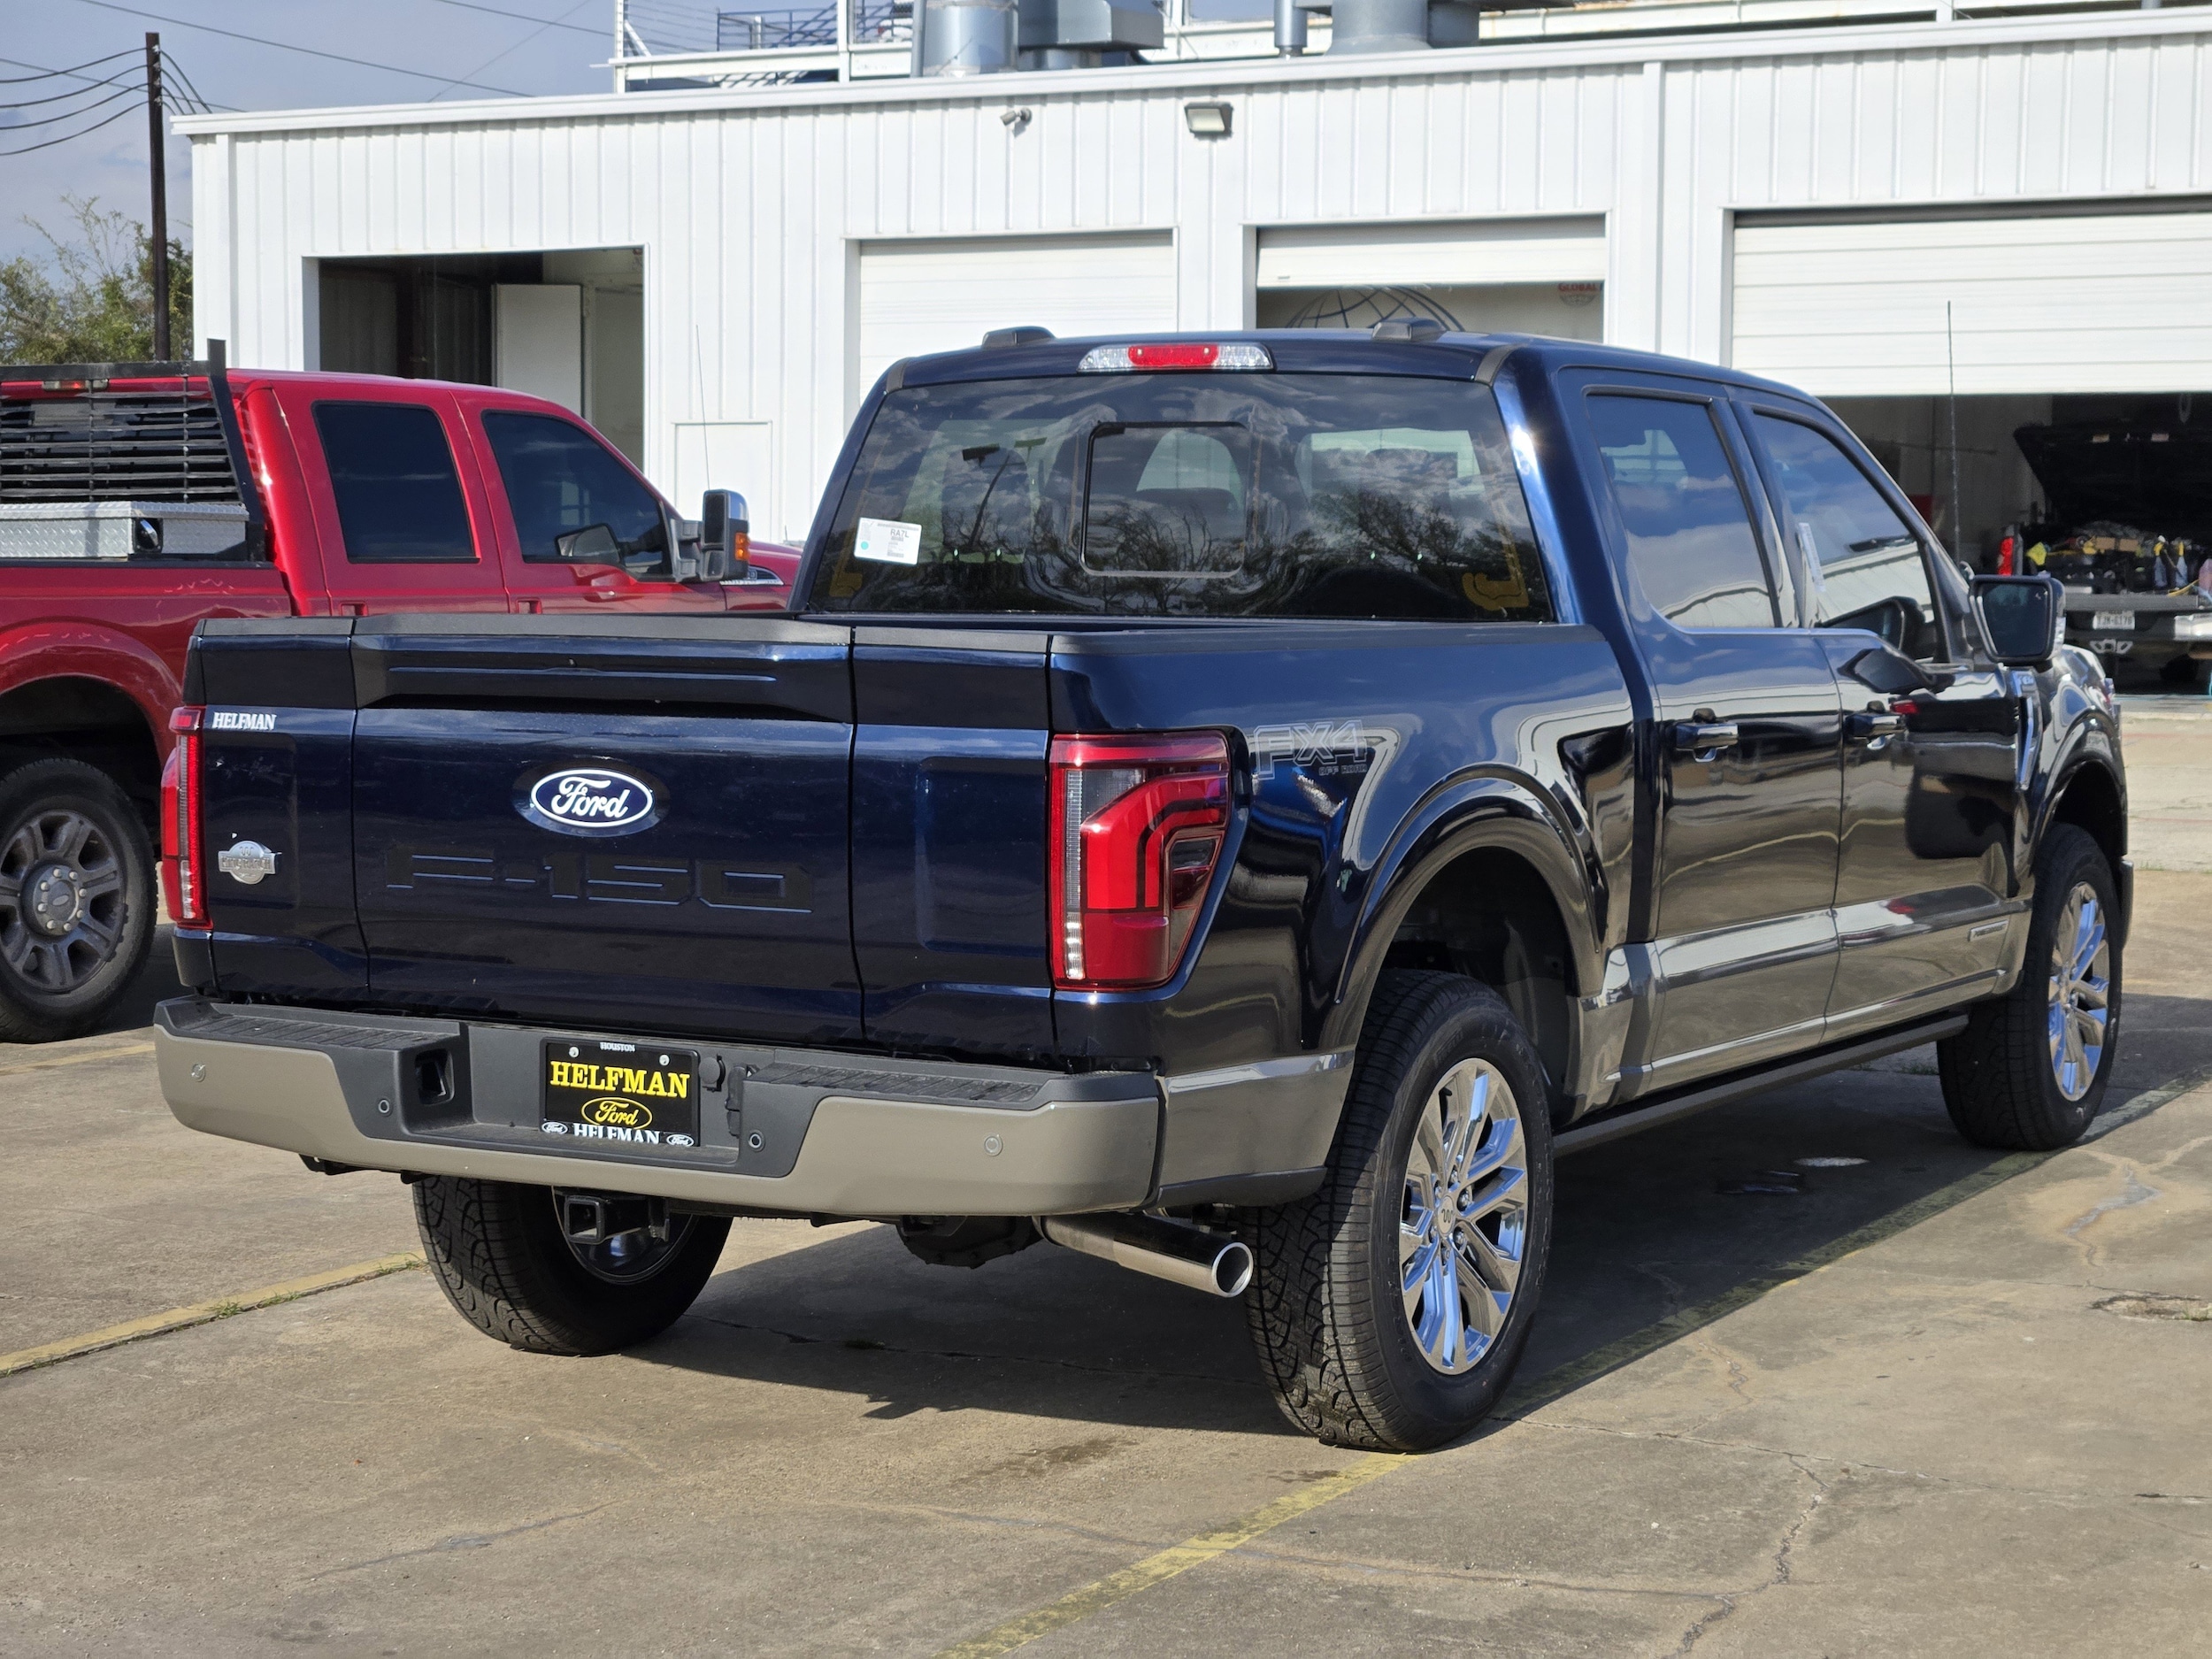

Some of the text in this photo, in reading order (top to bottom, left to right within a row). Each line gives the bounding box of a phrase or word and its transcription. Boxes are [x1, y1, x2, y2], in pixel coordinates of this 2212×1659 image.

[890, 528, 910, 538] RA7L
[211, 711, 277, 731] HELFMAN
[1254, 719, 1368, 780] FX4
[1318, 765, 1340, 776] OFF
[550, 776, 629, 818] Ford
[385, 843, 813, 913] F-150
[599, 1041, 635, 1052] HOUSTON
[549, 1060, 690, 1099] HELFMAN
[595, 1100, 640, 1126] Ford
